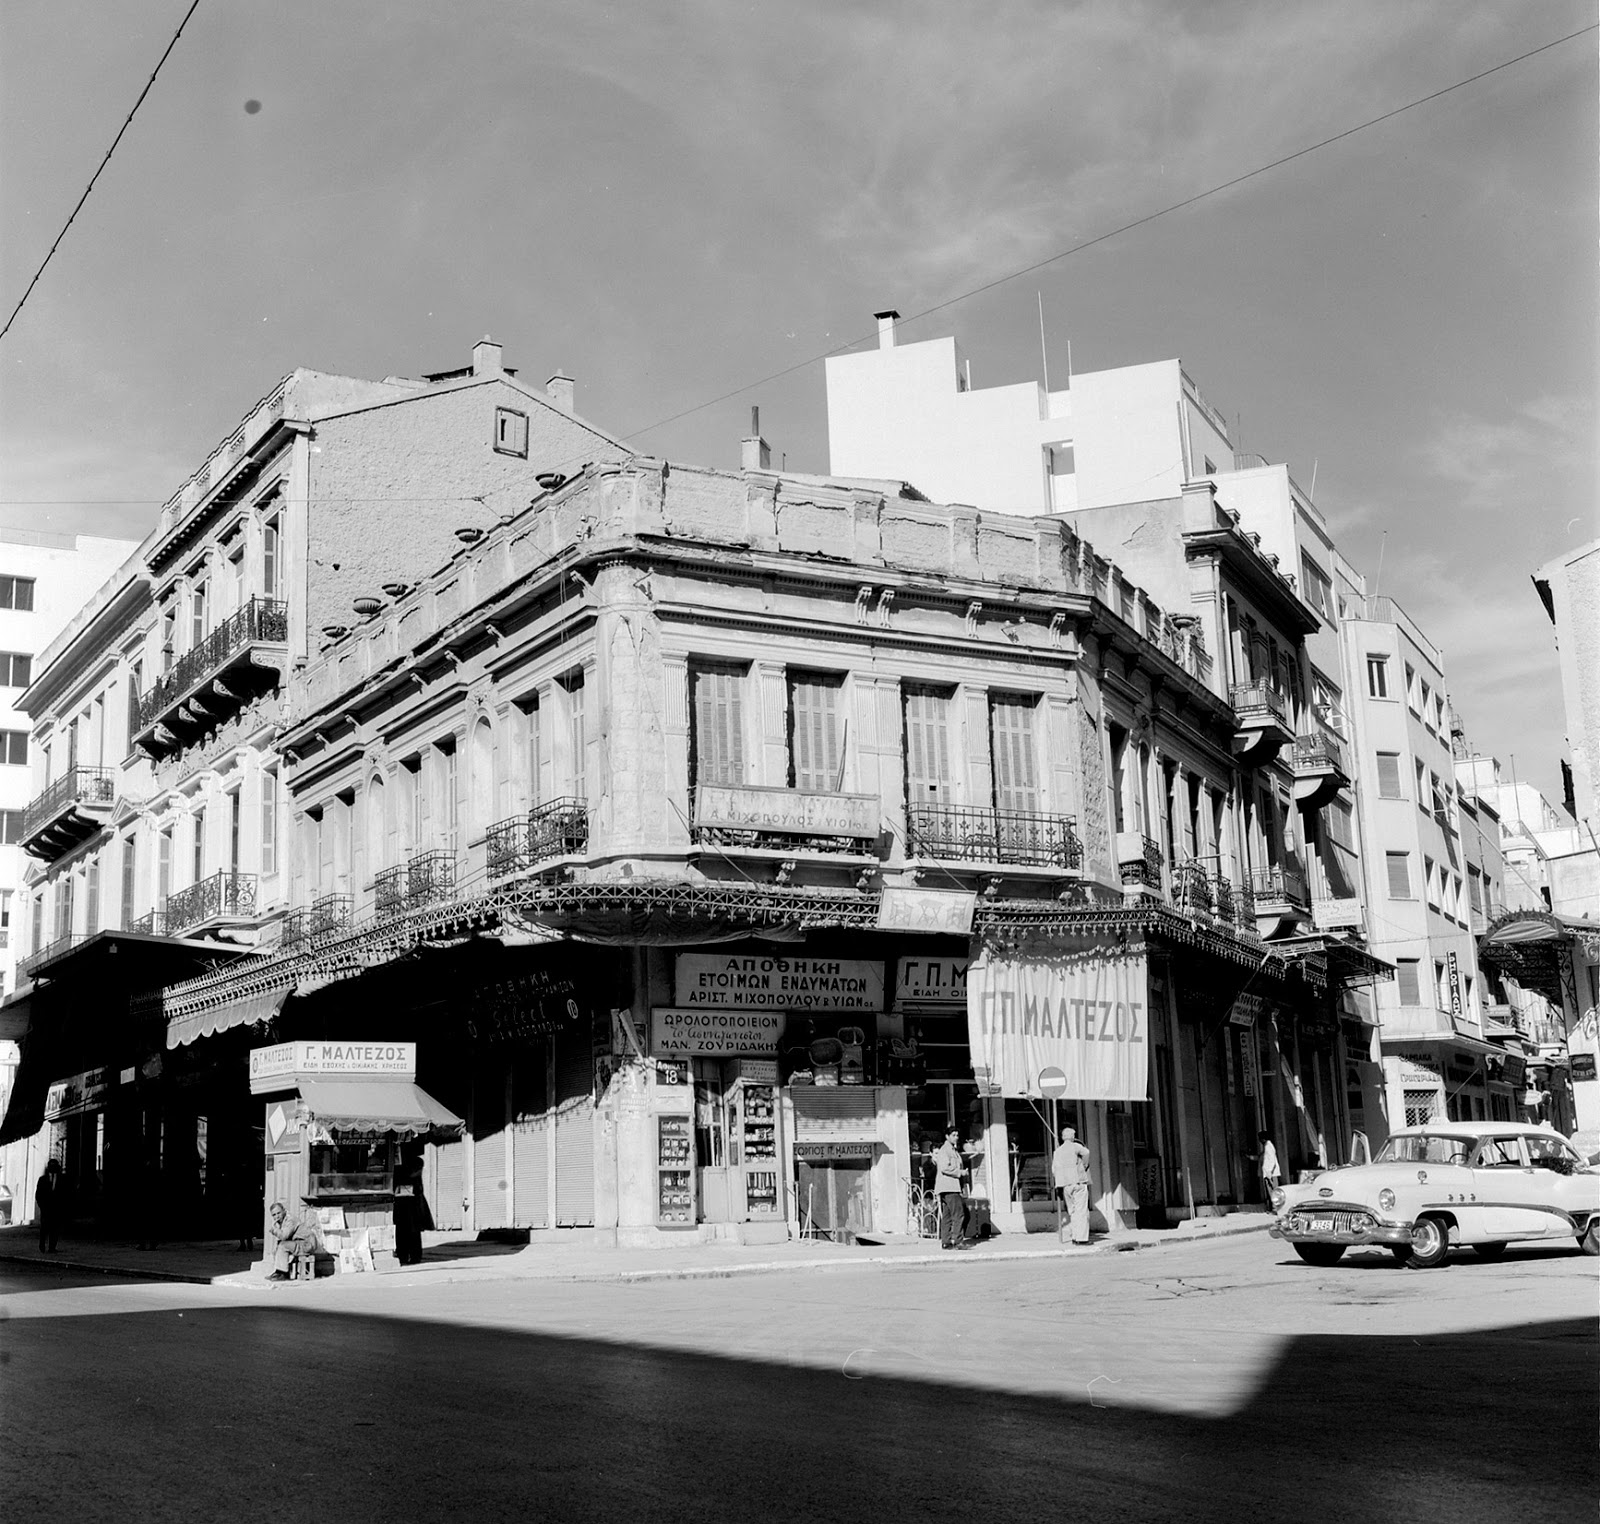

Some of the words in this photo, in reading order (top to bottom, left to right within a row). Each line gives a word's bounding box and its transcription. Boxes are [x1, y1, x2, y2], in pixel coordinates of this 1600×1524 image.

[726, 959, 841, 974] ΑΠΟΘΗΚΗ
[699, 973, 770, 989] ΕΤΟΙΜΩΝ
[781, 975, 867, 992] ΕΝΔΥΜΑΤΩΝ
[1447, 950, 1462, 1015] ΓΡΗΓΟΡΙΑΔΗΣ
[688, 991, 728, 1003] ΑΡΙΣΤ.
[734, 993, 820, 1006] ΜΙΧΟΠΟΥΛΟΥ
[832, 996, 863, 1007] ΥΙΩΝ
[913, 989, 940, 997] ΕΙΔΗ
[664, 1015, 778, 1028] ΩΡΟΛΟΓΟΠΟΙΕΙΟΝ
[661, 1040, 690, 1050] ΜΑΝ.
[264, 1047, 293, 1065] ΜΑΛΤΕΖΟΣ
[305, 1046, 316, 1060] Γ.
[322, 1046, 406, 1061] ΜΑΛΤΕΖΟΣ
[665, 1069, 679, 1084] 18
[836, 1145, 872, 1155] ΜΑΛΤΕΖΟΣ
